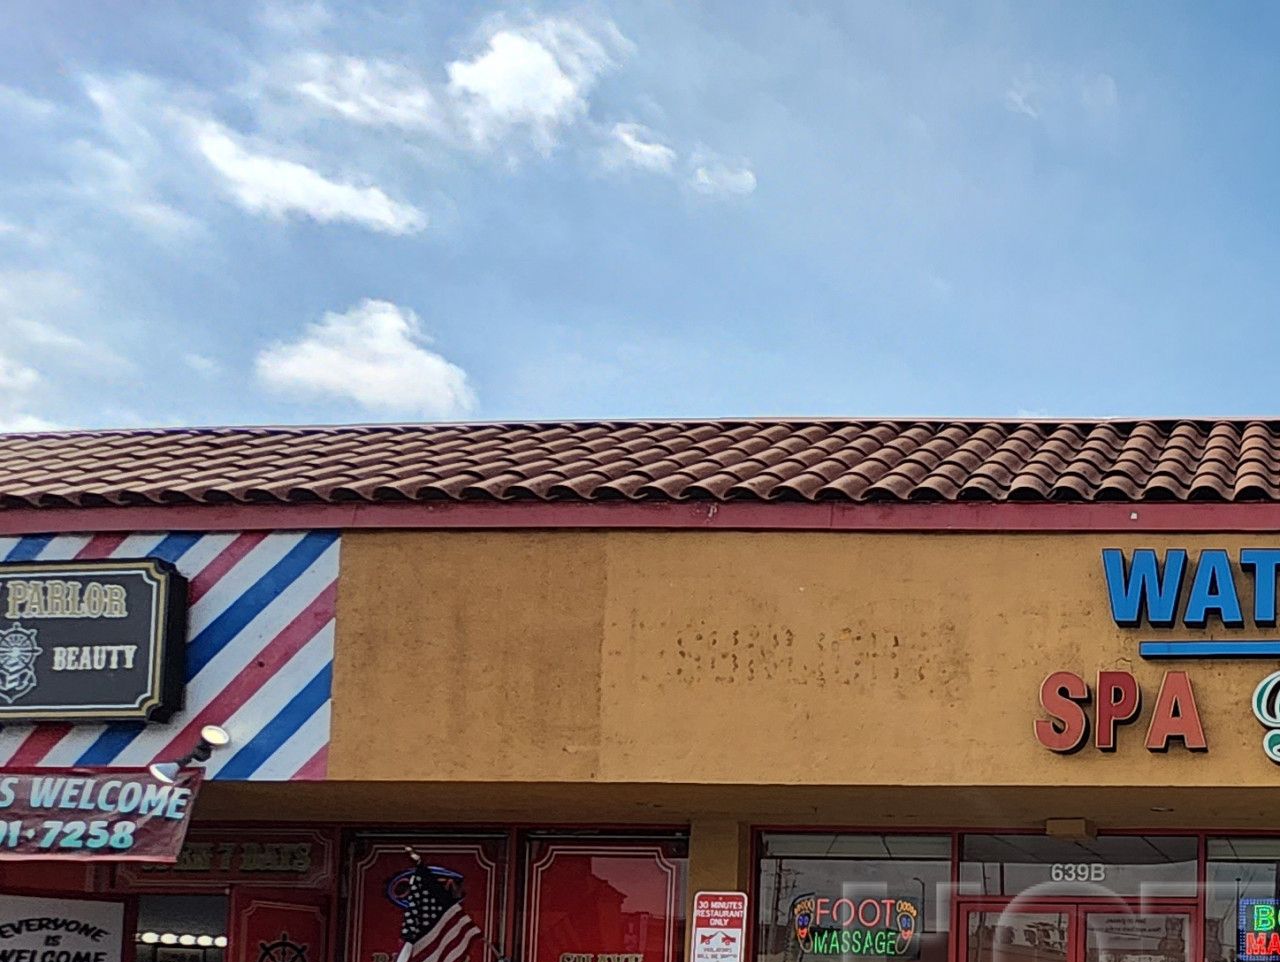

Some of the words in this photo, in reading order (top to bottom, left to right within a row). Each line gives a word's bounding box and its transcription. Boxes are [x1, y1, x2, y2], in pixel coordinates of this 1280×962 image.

[4, 580, 128, 619] PARLOR
[52, 645, 138, 671] BEAUTY
[1033, 670, 1208, 753] SPA
[29, 777, 191, 819] WELCOME
[1051, 864, 1106, 882] 639B
[696, 910, 743, 918] RESTAURANT
[698, 901, 709, 909] 30
[711, 901, 742, 910] MINUTES
[816, 899, 895, 927] FOOT
[0, 917, 111, 942] EVERYONE
[709, 918, 730, 926] ONLY
[44, 935, 62, 947] IS
[814, 930, 896, 954] MASSAGE
